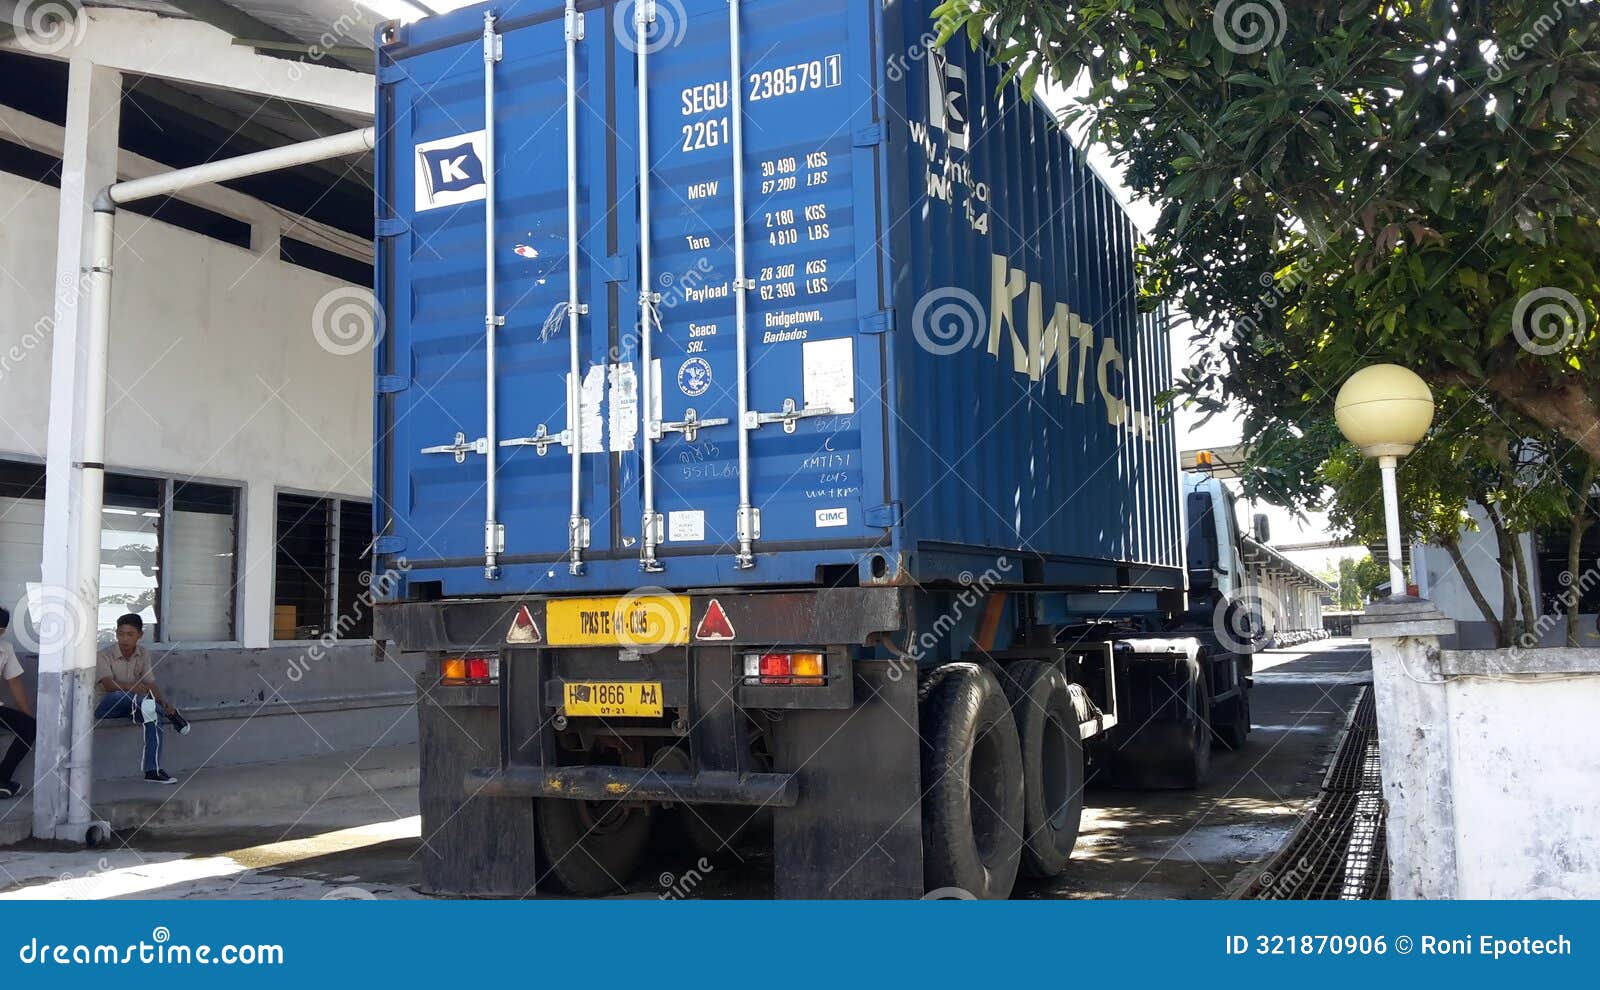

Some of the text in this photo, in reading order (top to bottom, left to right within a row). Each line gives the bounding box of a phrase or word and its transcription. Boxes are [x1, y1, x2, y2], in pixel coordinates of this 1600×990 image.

[681, 80, 728, 116] SEGU
[749, 60, 822, 102] 238579
[682, 117, 729, 153] 22G1
[440, 155, 470, 183] K
[761, 151, 828, 177] 30 480 KGS
[687, 181, 719, 200] MGW
[761, 171, 828, 194] 67 200 LBS
[774, 209, 794, 226] 180
[804, 204, 826, 222] KGS
[686, 235, 711, 250] Tare
[808, 223, 830, 241] LBS
[760, 259, 827, 282] 28 300 KGS
[685, 282, 728, 304] Payload
[760, 277, 828, 301] 62 390 LBS
[765, 310, 823, 329] Bridgetown,
[689, 323, 717, 339] Seaco
[763, 328, 808, 344] Barbados
[687, 340, 707, 354] SRL.
[818, 512, 845, 522] CIMC
[600, 611, 610, 634] TE
[592, 684, 625, 705] 1866
